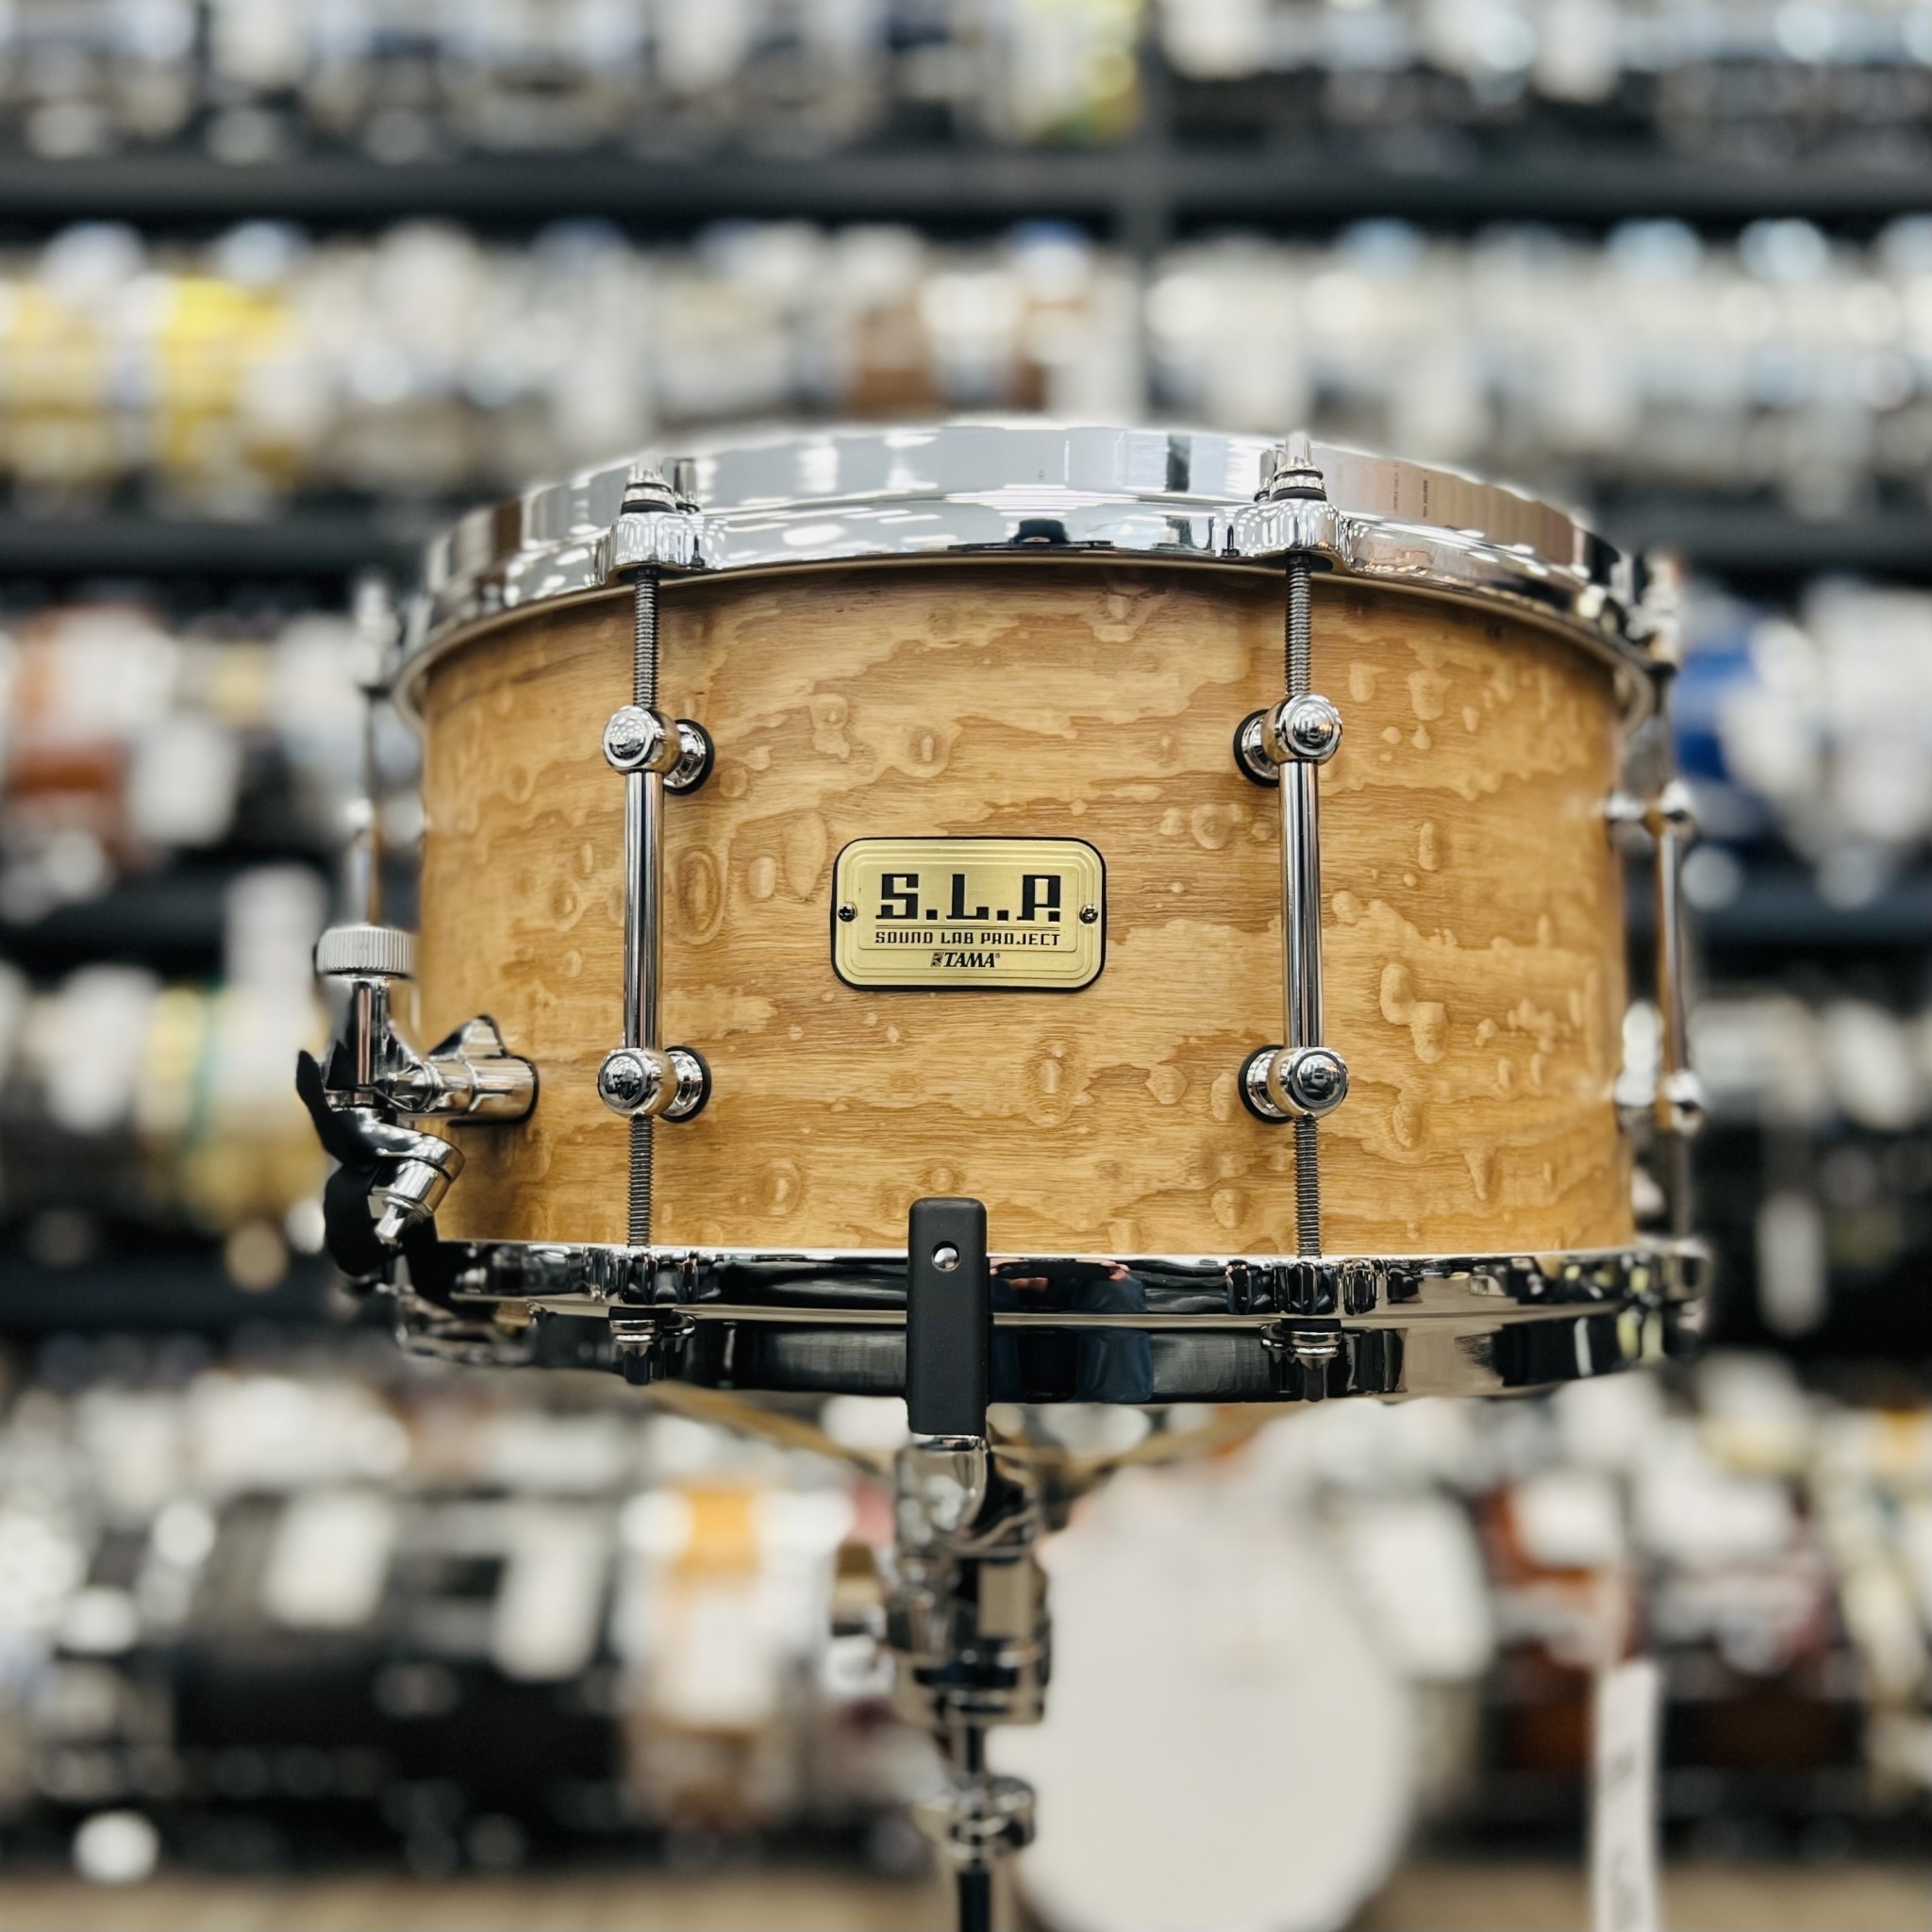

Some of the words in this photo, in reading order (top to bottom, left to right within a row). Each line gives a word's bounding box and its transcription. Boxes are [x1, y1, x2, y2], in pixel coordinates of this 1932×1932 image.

[875, 932, 933, 944] SOUND
[941, 932, 974, 944] LAB
[980, 933, 1060, 946] PROJECT
